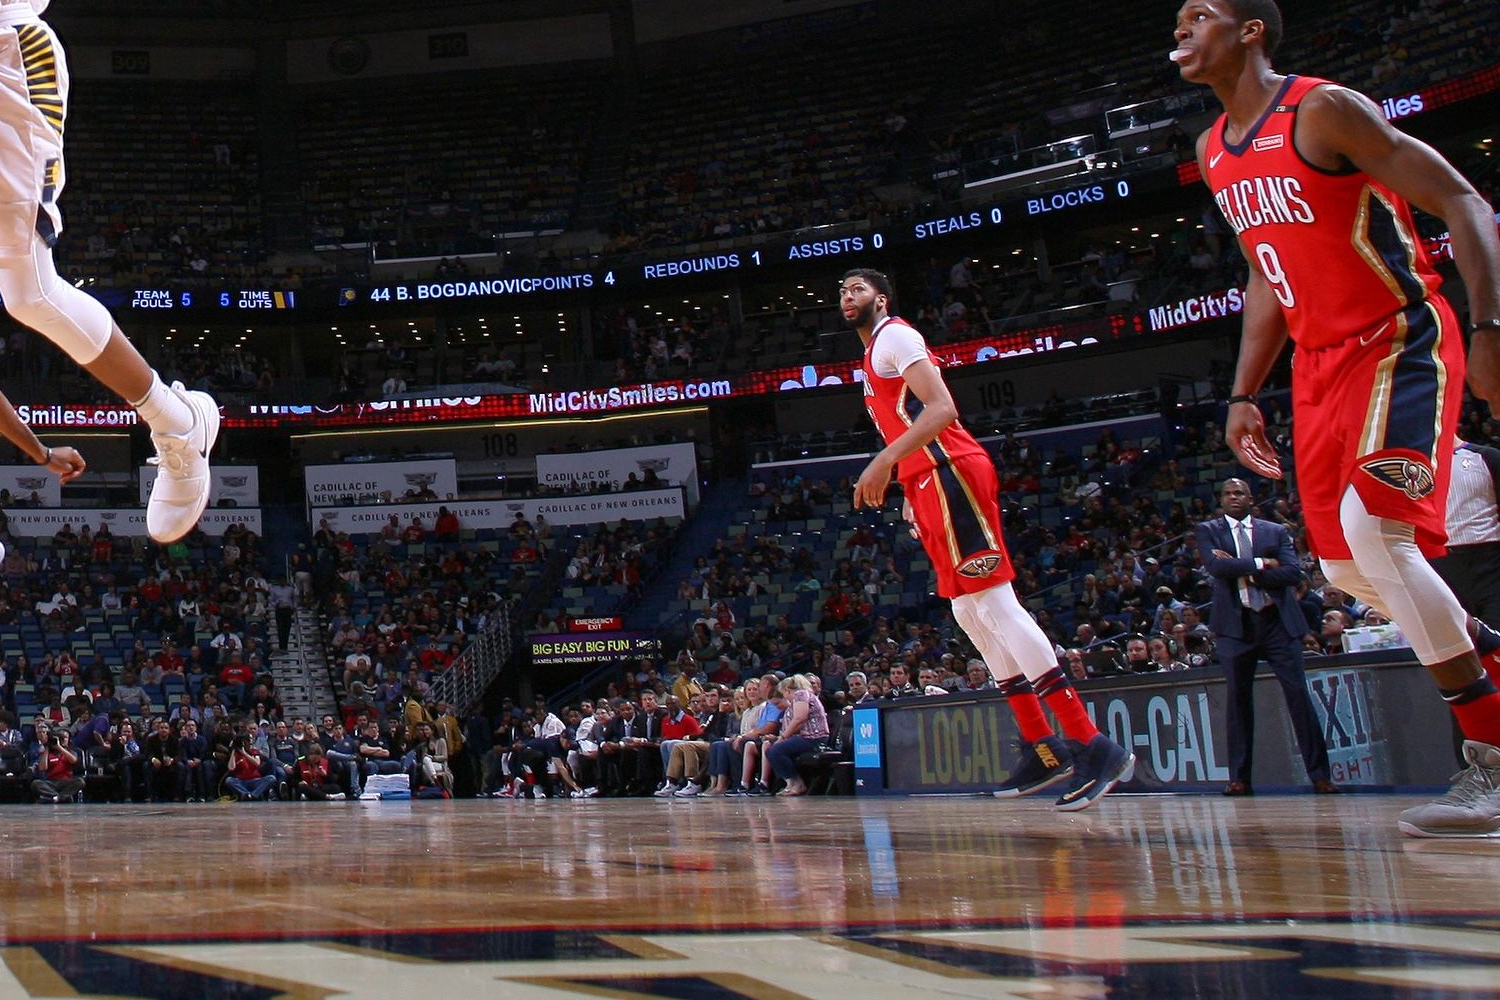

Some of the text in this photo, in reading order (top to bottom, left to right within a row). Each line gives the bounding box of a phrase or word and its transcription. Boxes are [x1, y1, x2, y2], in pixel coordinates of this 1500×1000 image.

[1214, 175, 1315, 235] ELICANS
[643, 180, 1129, 280] REBOUNDS 1 ASSISTS 0 STEALS 0 BLOCKS 0
[1255, 241, 1295, 308] 9
[371, 271, 615, 301] 44 B. BOGDANOVIC POINTS 4
[135, 290, 170, 300] TEAM
[181, 293, 191, 306] 5
[220, 293, 230, 306] 5
[241, 290, 270, 300] TIME
[132, 299, 173, 309] FOULS
[239, 299, 273, 308] OUTS
[528, 377, 732, 414] MidCitySmiles.com
[978, 380, 1015, 410] 109
[481, 433, 518, 459] 108
[545, 470, 611, 482] CADILLAC OF
[313, 481, 378, 492] CADILLAC OF
[538, 496, 677, 513] CADILLAC OF NEW ORLEANS
[21, 515, 41, 523] NEW
[44, 515, 86, 523] ORLEANS
[532, 643, 552, 655] BIG
[554, 642, 583, 653] EASY.
[585, 641, 606, 652] BIG
[607, 639, 633, 651] FUN.
[917, 706, 1011, 785] LOCAL
